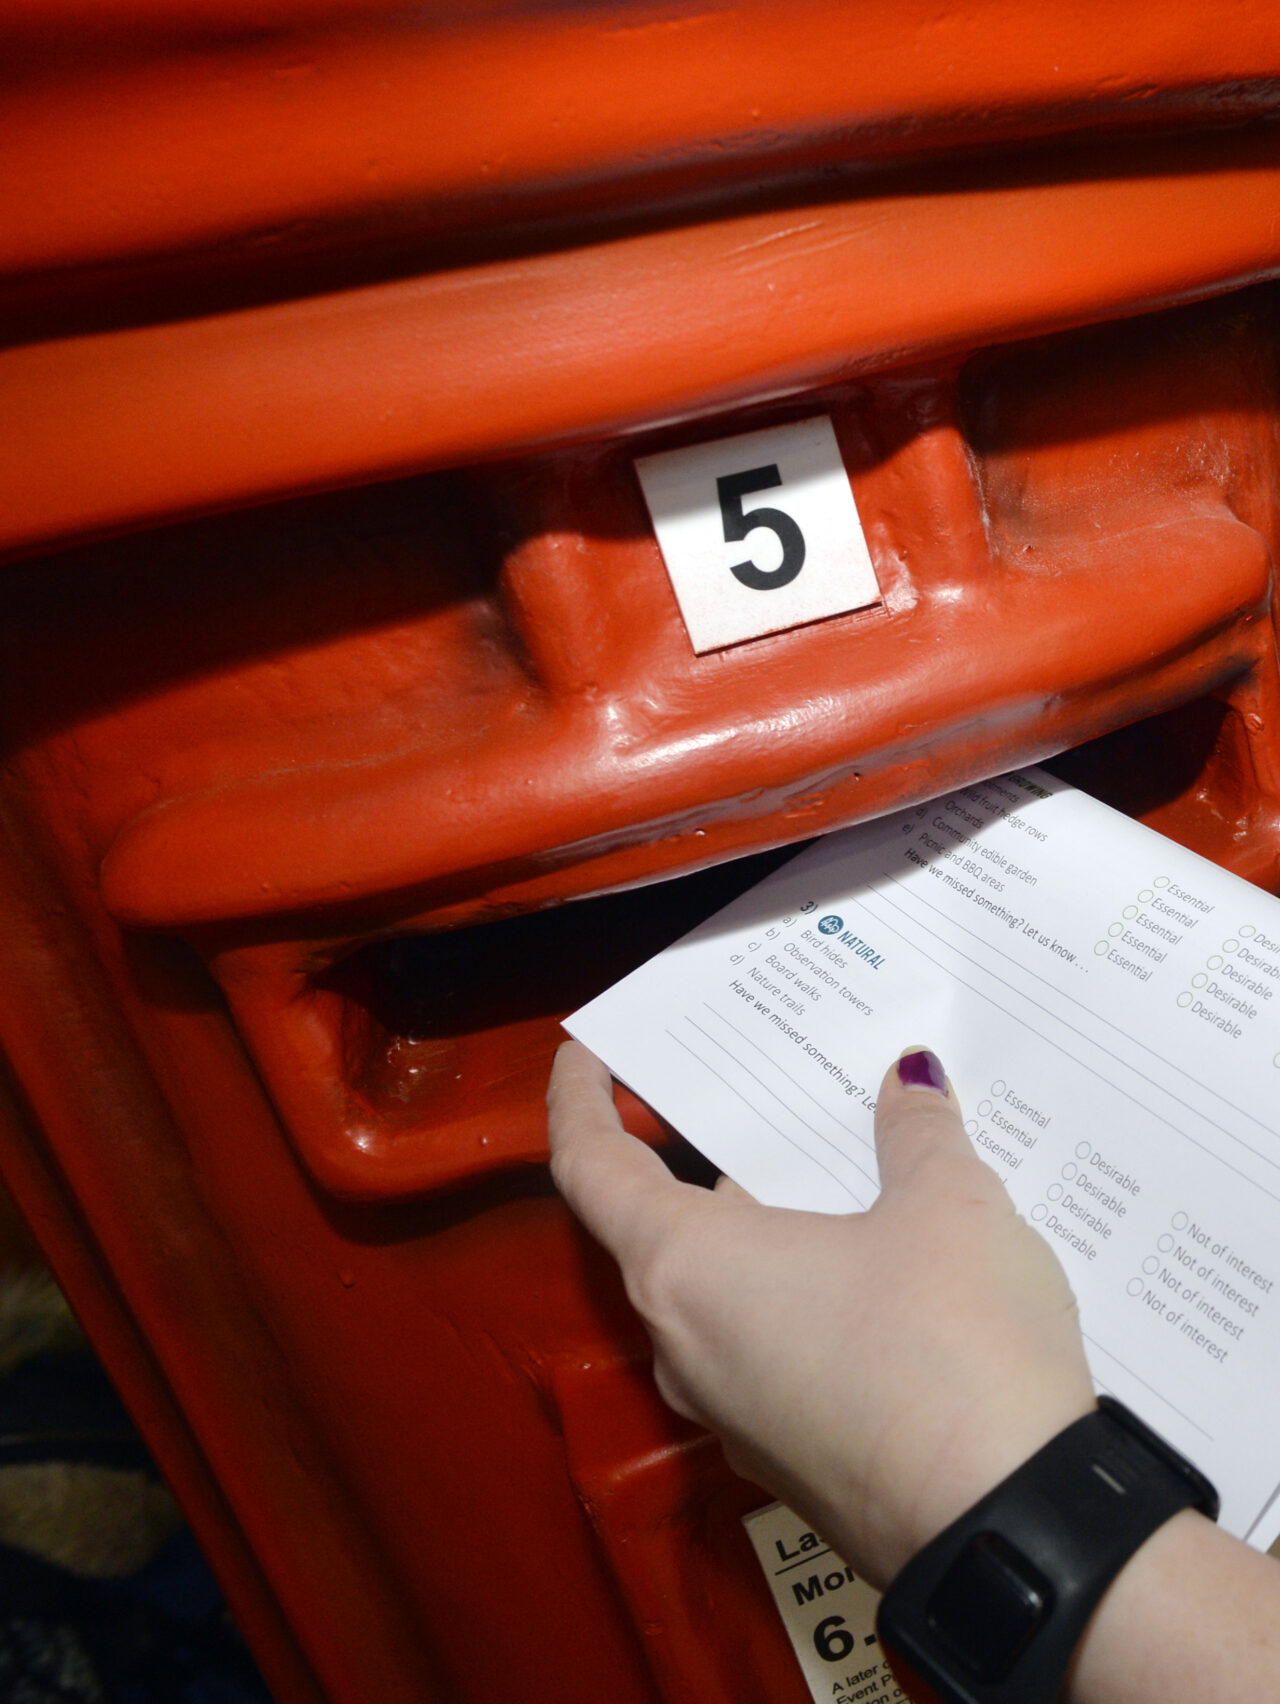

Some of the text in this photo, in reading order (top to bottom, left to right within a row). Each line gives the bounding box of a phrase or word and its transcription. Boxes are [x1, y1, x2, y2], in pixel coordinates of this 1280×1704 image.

[716, 463, 806, 591] 5
[945, 800, 985, 829] Orchards
[980, 797, 999, 815] fruit
[999, 808, 1026, 830] hedge
[1024, 825, 1048, 842] rows
[919, 832, 946, 855] Picnic
[945, 848, 963, 866] and
[962, 859, 983, 879] BBQ
[981, 873, 1006, 892] areas
[932, 816, 982, 854] Community
[981, 846, 1008, 869] edible
[1004, 862, 1038, 887] garden
[904, 848, 928, 869] Have
[928, 864, 944, 879] we
[942, 873, 976, 899] missed
[973, 894, 1025, 929] something?
[1022, 922, 1039, 940] Let
[1037, 932, 1051, 948] us
[1151, 897, 1199, 929] Essential
[1167, 884, 1216, 915] Essential
[782, 916, 848, 970] a) Bird hides
[800, 900, 885, 970] 3) NATURAL
[1121, 930, 1169, 964] Essential
[1136, 913, 1184, 946] Essential
[729, 954, 806, 1016] d) Nature trails
[747, 942, 822, 1002] c) Board walks
[765, 928, 874, 1017] b) Observation towers
[1106, 948, 1154, 983] Essential
[1220, 964, 1273, 1001] Desirable
[1191, 1000, 1243, 1039] Desirable
[1206, 981, 1258, 1020] Desirable
[728, 979, 876, 1113] Have we missed something? Le
[990, 1110, 1038, 1150] Essential
[1004, 1089, 1052, 1129] Essential
[975, 1130, 1024, 1170] Essential
[1075, 1173, 1127, 1218] Desirable
[1089, 1152, 1141, 1197] Desirable
[1045, 1215, 1097, 1261] Desirable
[1061, 1194, 1113, 1240] Desirable
[1187, 1223, 1274, 1294] Not of interest
[1157, 1268, 1245, 1341] Not of interest
[1173, 1246, 1260, 1318] Not of interest
[1142, 1289, 1229, 1364] Not of interest
[775, 1531, 822, 1562] La
[832, 1682, 844, 1695] A
[846, 1664, 880, 1688] later
[836, 1681, 879, 1704] Event
